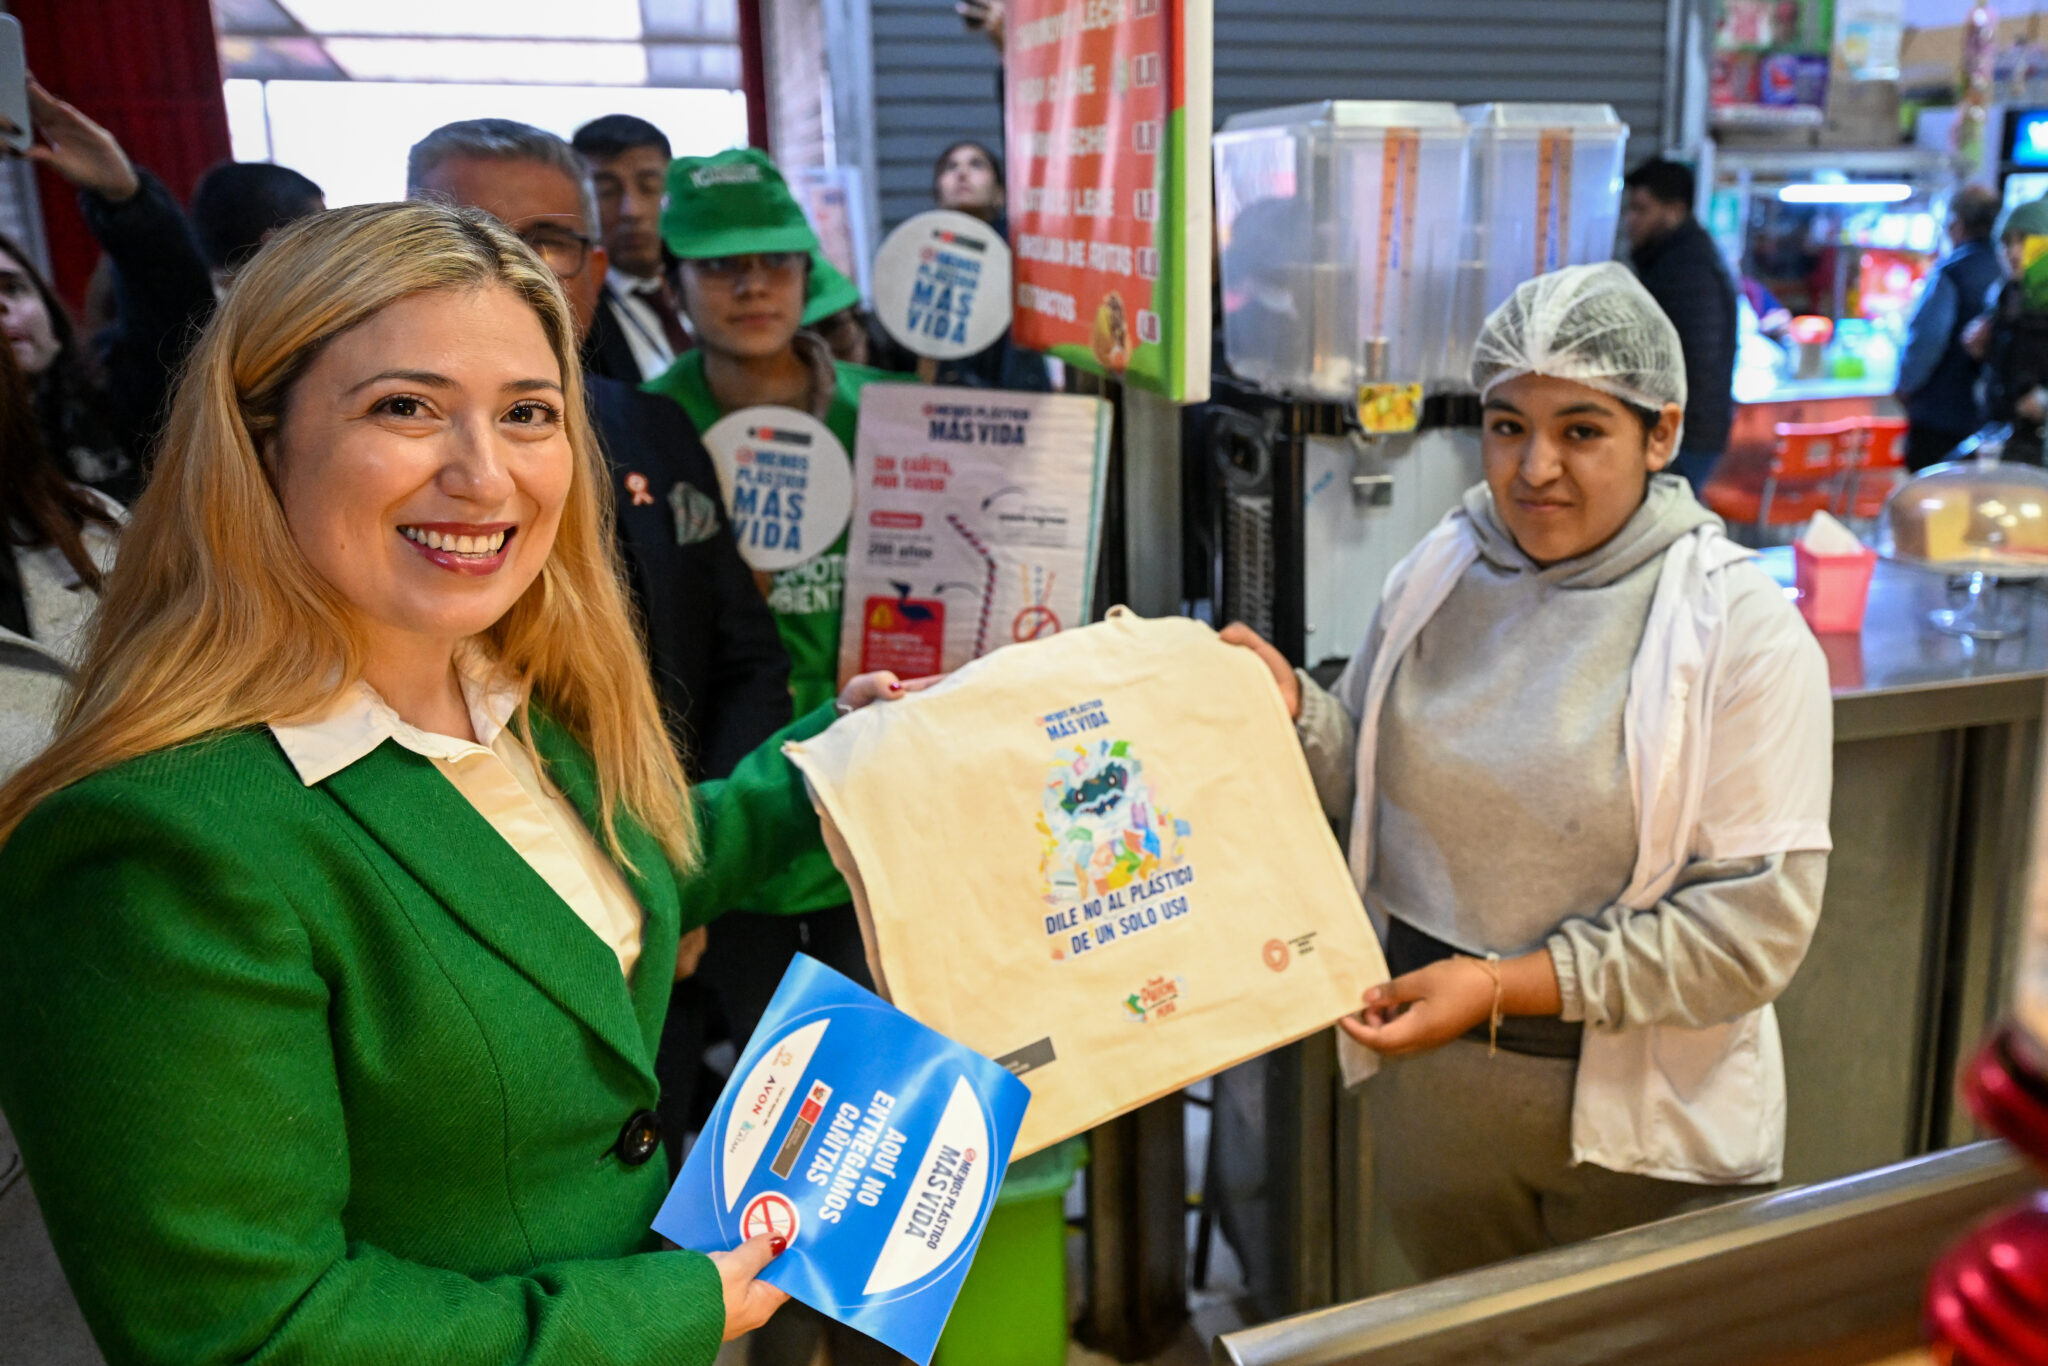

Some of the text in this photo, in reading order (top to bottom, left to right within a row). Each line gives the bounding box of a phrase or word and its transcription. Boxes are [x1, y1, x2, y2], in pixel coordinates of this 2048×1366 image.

[913, 279, 973, 317] MÁS
[907, 310, 967, 345] VIDA
[929, 418, 1025, 445] MÁS VIDA
[755, 451, 808, 470] MENOS
[733, 484, 804, 521] MÁS
[730, 519, 801, 551] VIDA
[1075, 710, 1110, 731] VIDA
[1045, 865, 1193, 935] DILE NO AL PLÁSTICO
[1071, 896, 1189, 954] DE UN SOLO USO
[752, 1075, 776, 1115] AVON
[806, 1101, 861, 1187] CAÑITAS
[818, 1089, 897, 1224] ENTREGAMOS
[856, 1126, 908, 1207] AQUÍ NO
[904, 1191, 943, 1239] VIDA
[926, 1159, 972, 1250] MENOS PLÁSTICO
